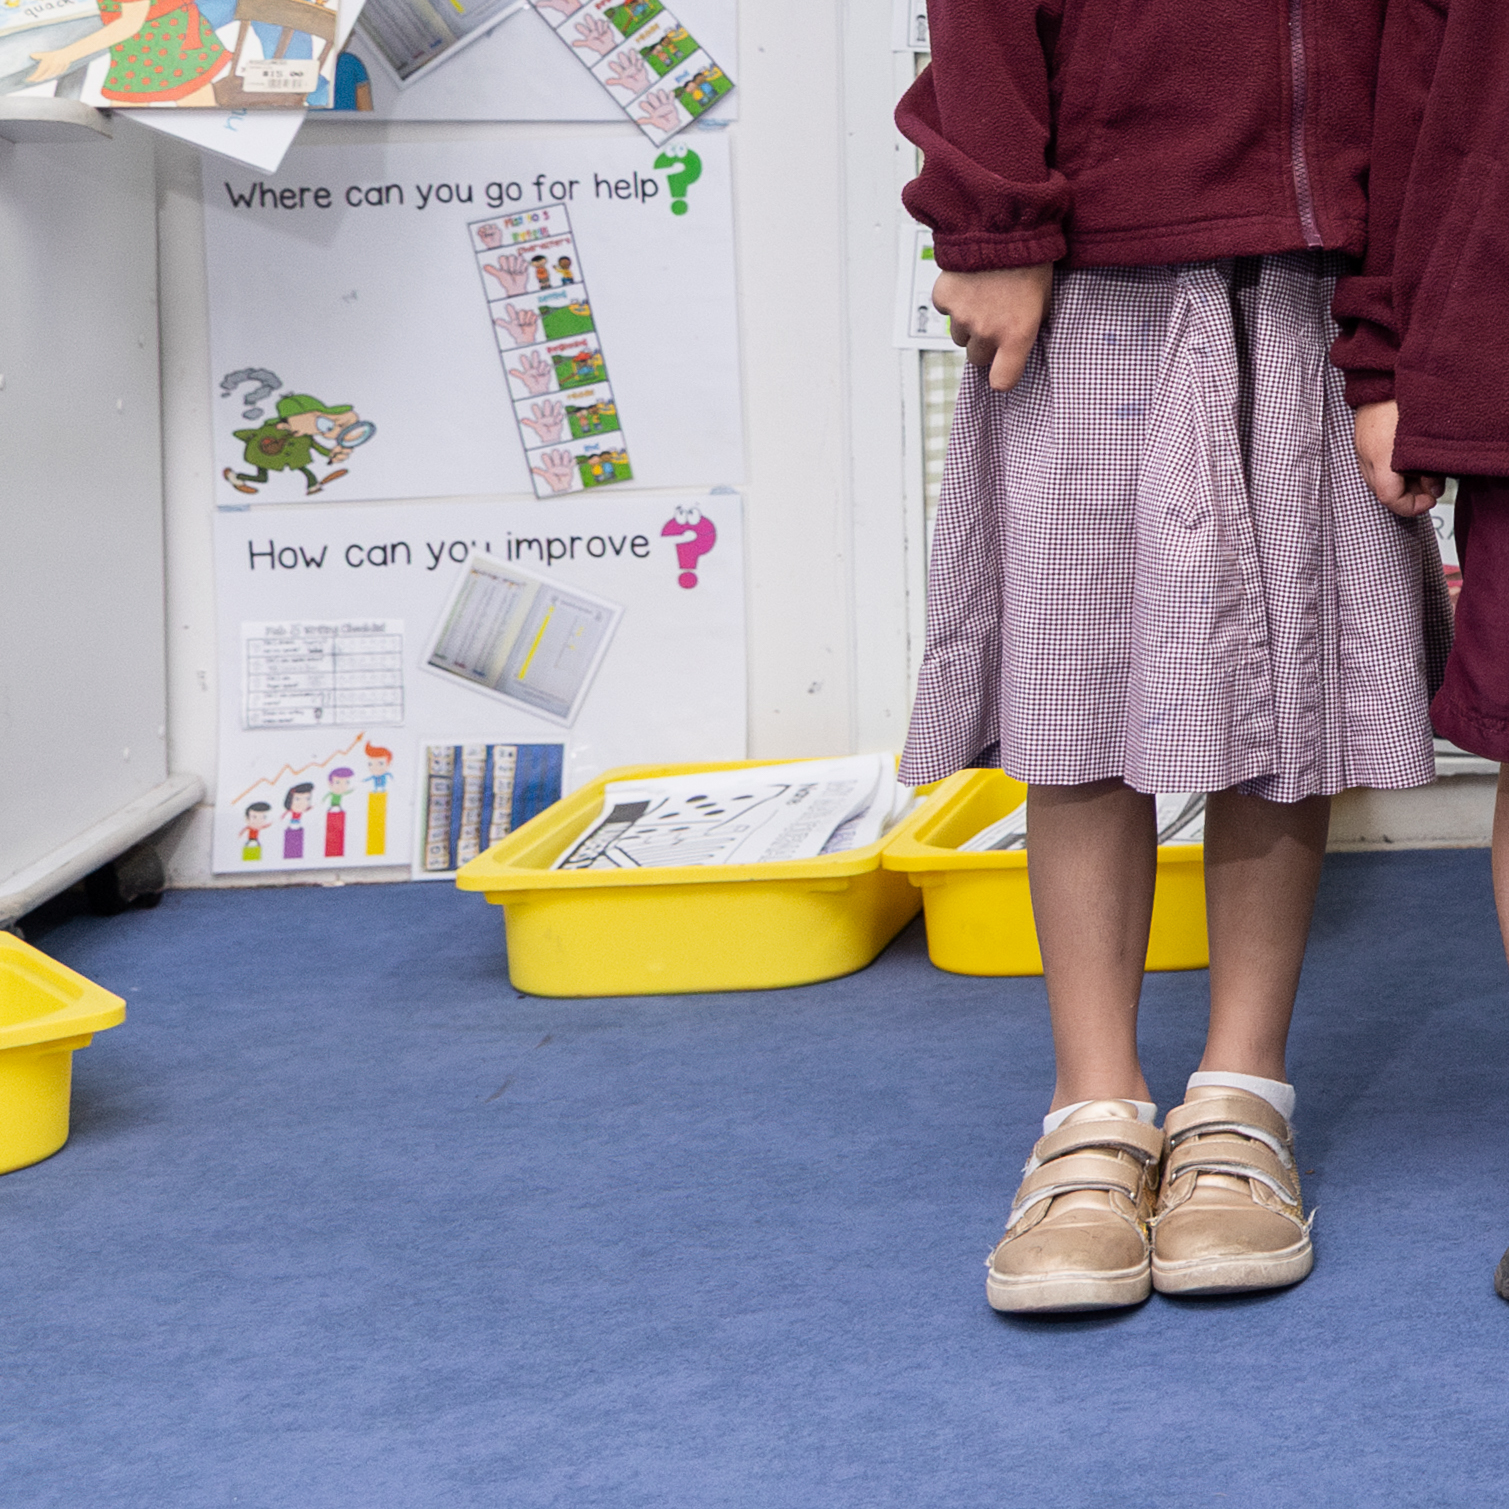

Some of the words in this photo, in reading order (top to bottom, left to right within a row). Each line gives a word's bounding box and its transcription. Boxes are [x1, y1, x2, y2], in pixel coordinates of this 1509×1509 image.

[224, 180, 332, 209] Where
[345, 180, 404, 208] can
[416, 180, 474, 209] you
[485, 182, 523, 208] go
[532, 174, 580, 201] for
[594, 172, 660, 203] help
[248, 539, 329, 569] How
[345, 540, 412, 568] can
[507, 531, 651, 566] improve
